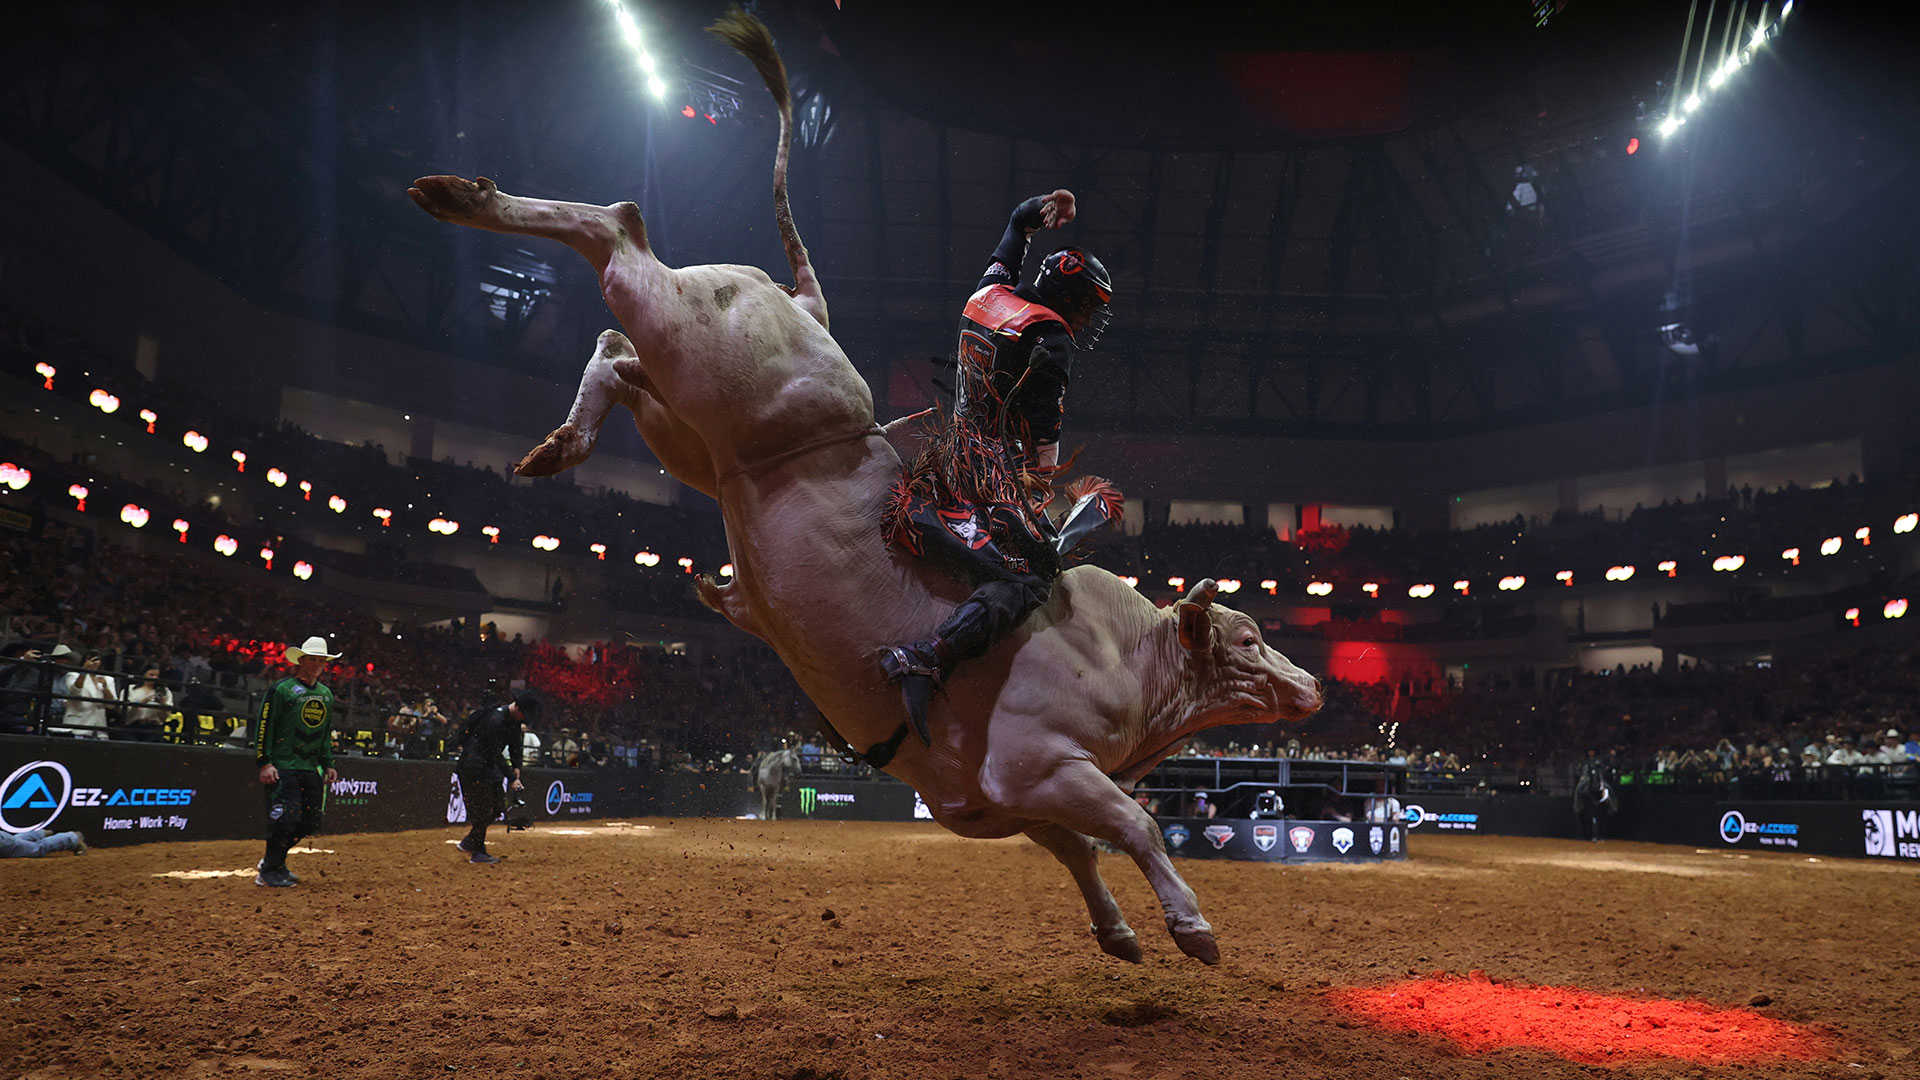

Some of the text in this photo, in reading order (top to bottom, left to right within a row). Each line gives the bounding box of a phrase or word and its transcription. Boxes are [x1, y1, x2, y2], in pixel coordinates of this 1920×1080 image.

[330, 777, 378, 796] MONSTER
[104, 815, 188, 831] Home Work Play
[1895, 809, 1920, 840] M
